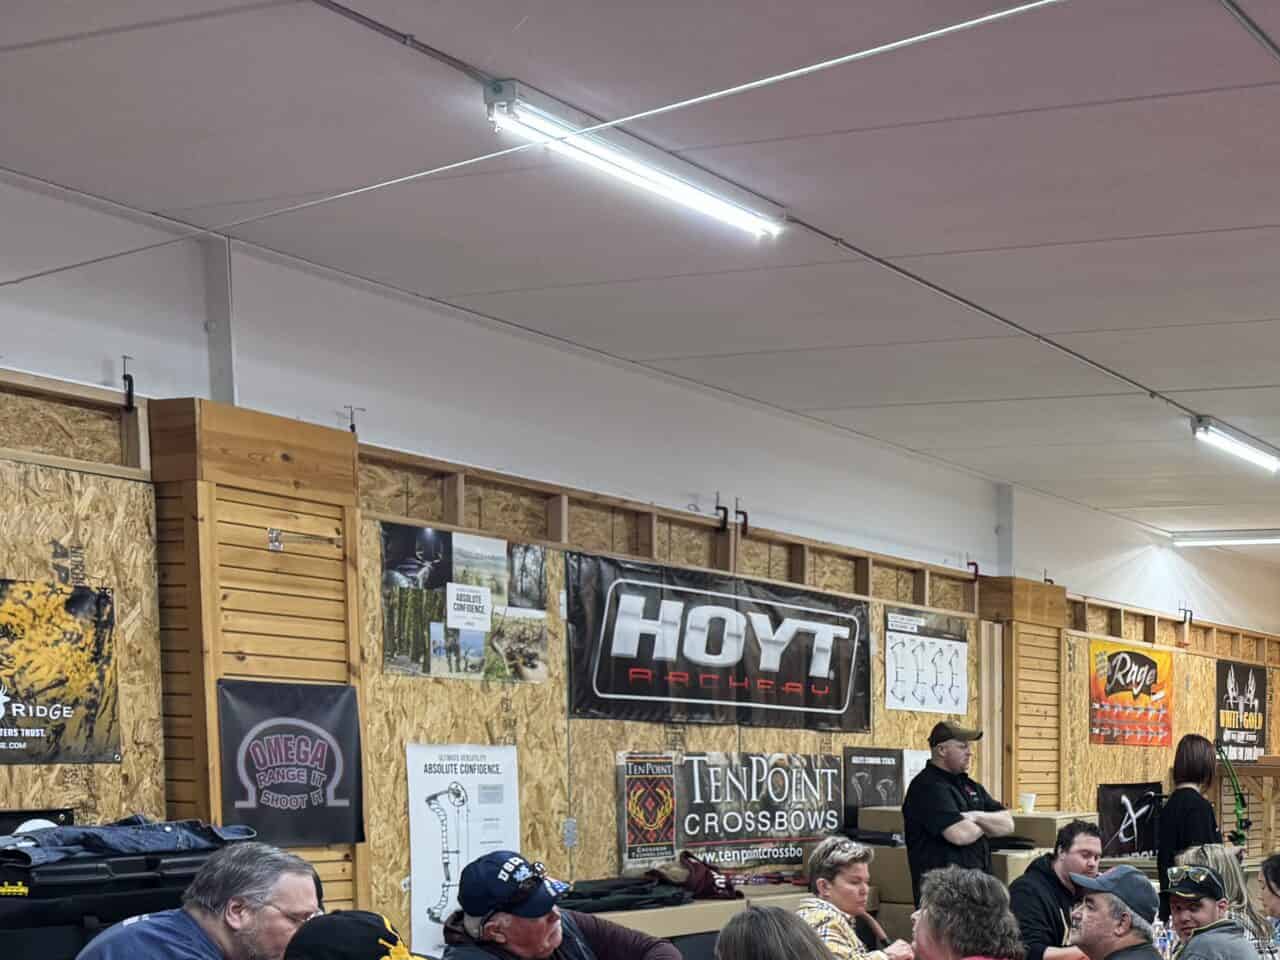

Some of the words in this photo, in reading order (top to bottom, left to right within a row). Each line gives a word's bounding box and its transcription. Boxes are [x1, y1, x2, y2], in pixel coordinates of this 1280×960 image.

[611, 594, 850, 680] HOYT
[627, 667, 831, 696] ARCHERY
[1106, 653, 1156, 696] Rage
[11, 703, 75, 719] RIDGE
[249, 735, 329, 771] OMEGA
[256, 767, 308, 788] RANGE
[310, 769, 327, 787] IT
[423, 763, 459, 775] ABSOLUTE
[683, 756, 838, 805] TENPOINT
[260, 789, 309, 810] SHOOT
[310, 788, 325, 806] IT
[684, 809, 839, 836] CROSSBOWS
